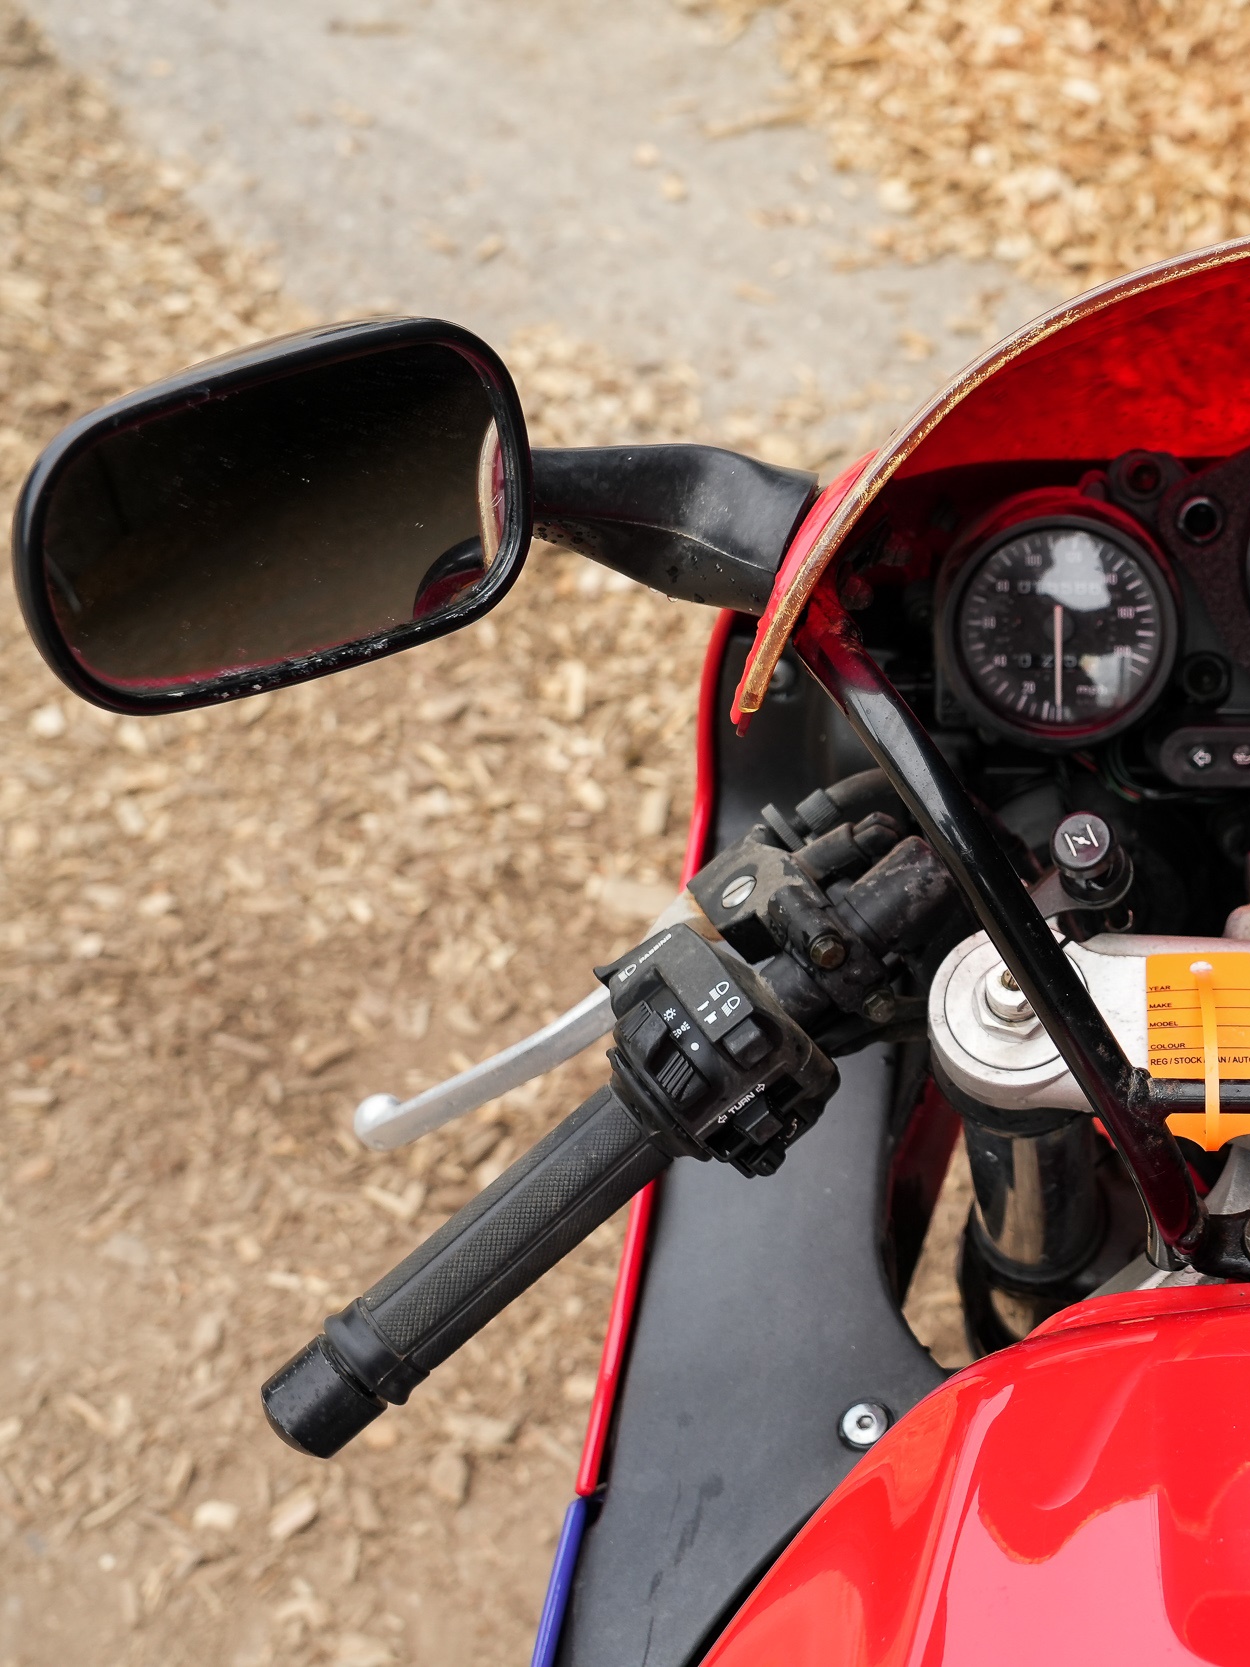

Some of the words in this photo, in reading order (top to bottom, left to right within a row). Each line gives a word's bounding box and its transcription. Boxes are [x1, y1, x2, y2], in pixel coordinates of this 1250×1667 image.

[638, 932, 673, 964] PASSING
[1150, 1058, 1169, 1066] REG
[1174, 1056, 1202, 1065] STOCK
[727, 1090, 756, 1115] TURN
